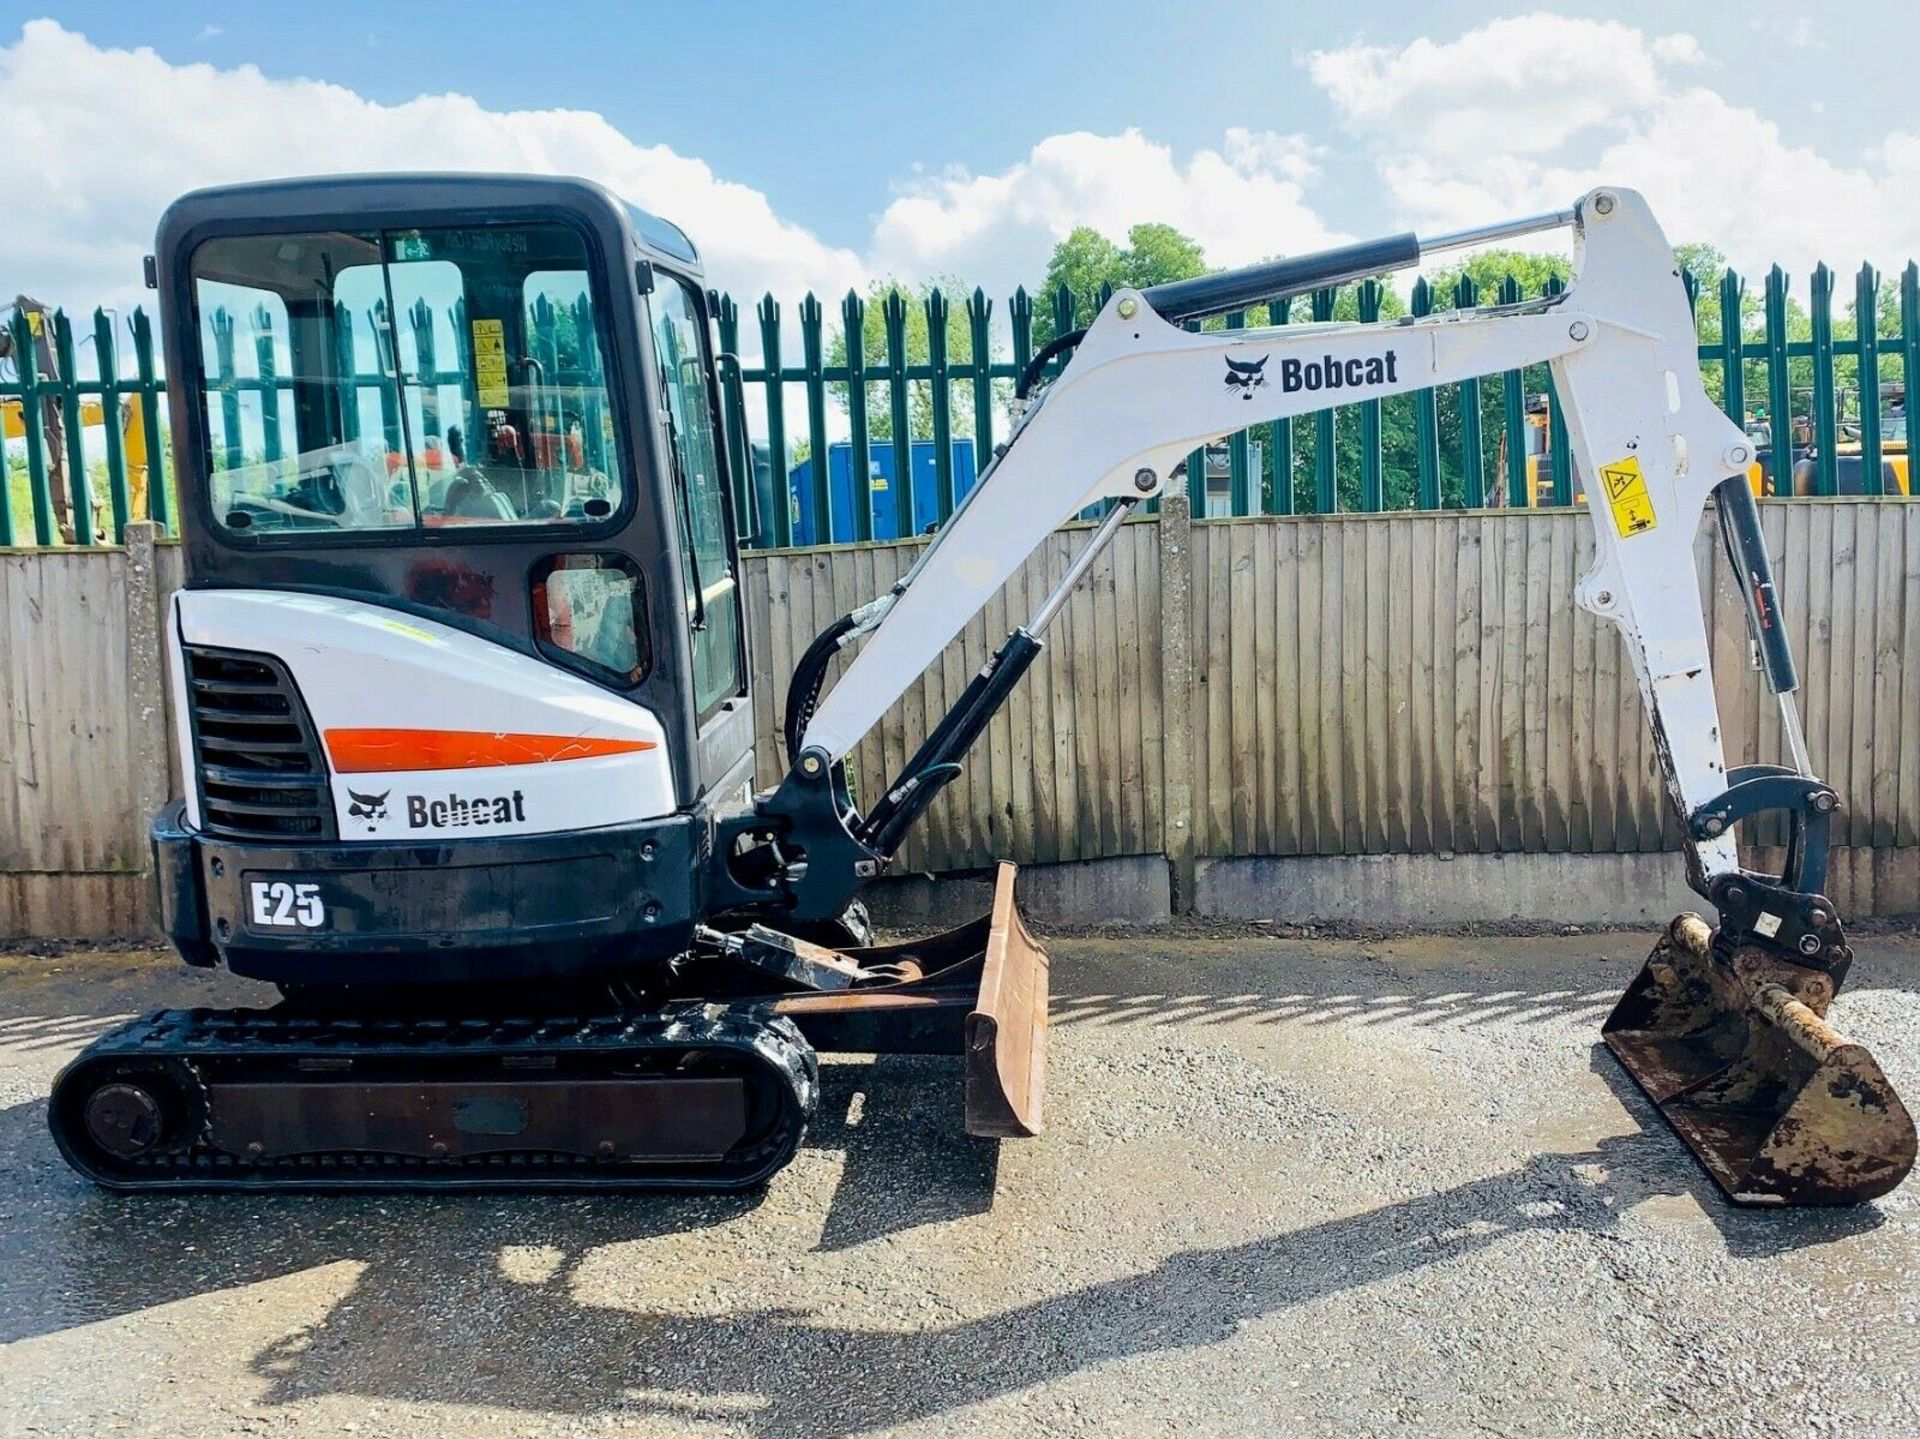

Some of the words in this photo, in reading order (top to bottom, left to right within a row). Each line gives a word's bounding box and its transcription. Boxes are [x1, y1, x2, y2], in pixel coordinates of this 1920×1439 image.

[1281, 350, 1397, 392] Bobcat
[407, 790, 526, 828] Bobcat
[250, 882, 325, 927] E25
